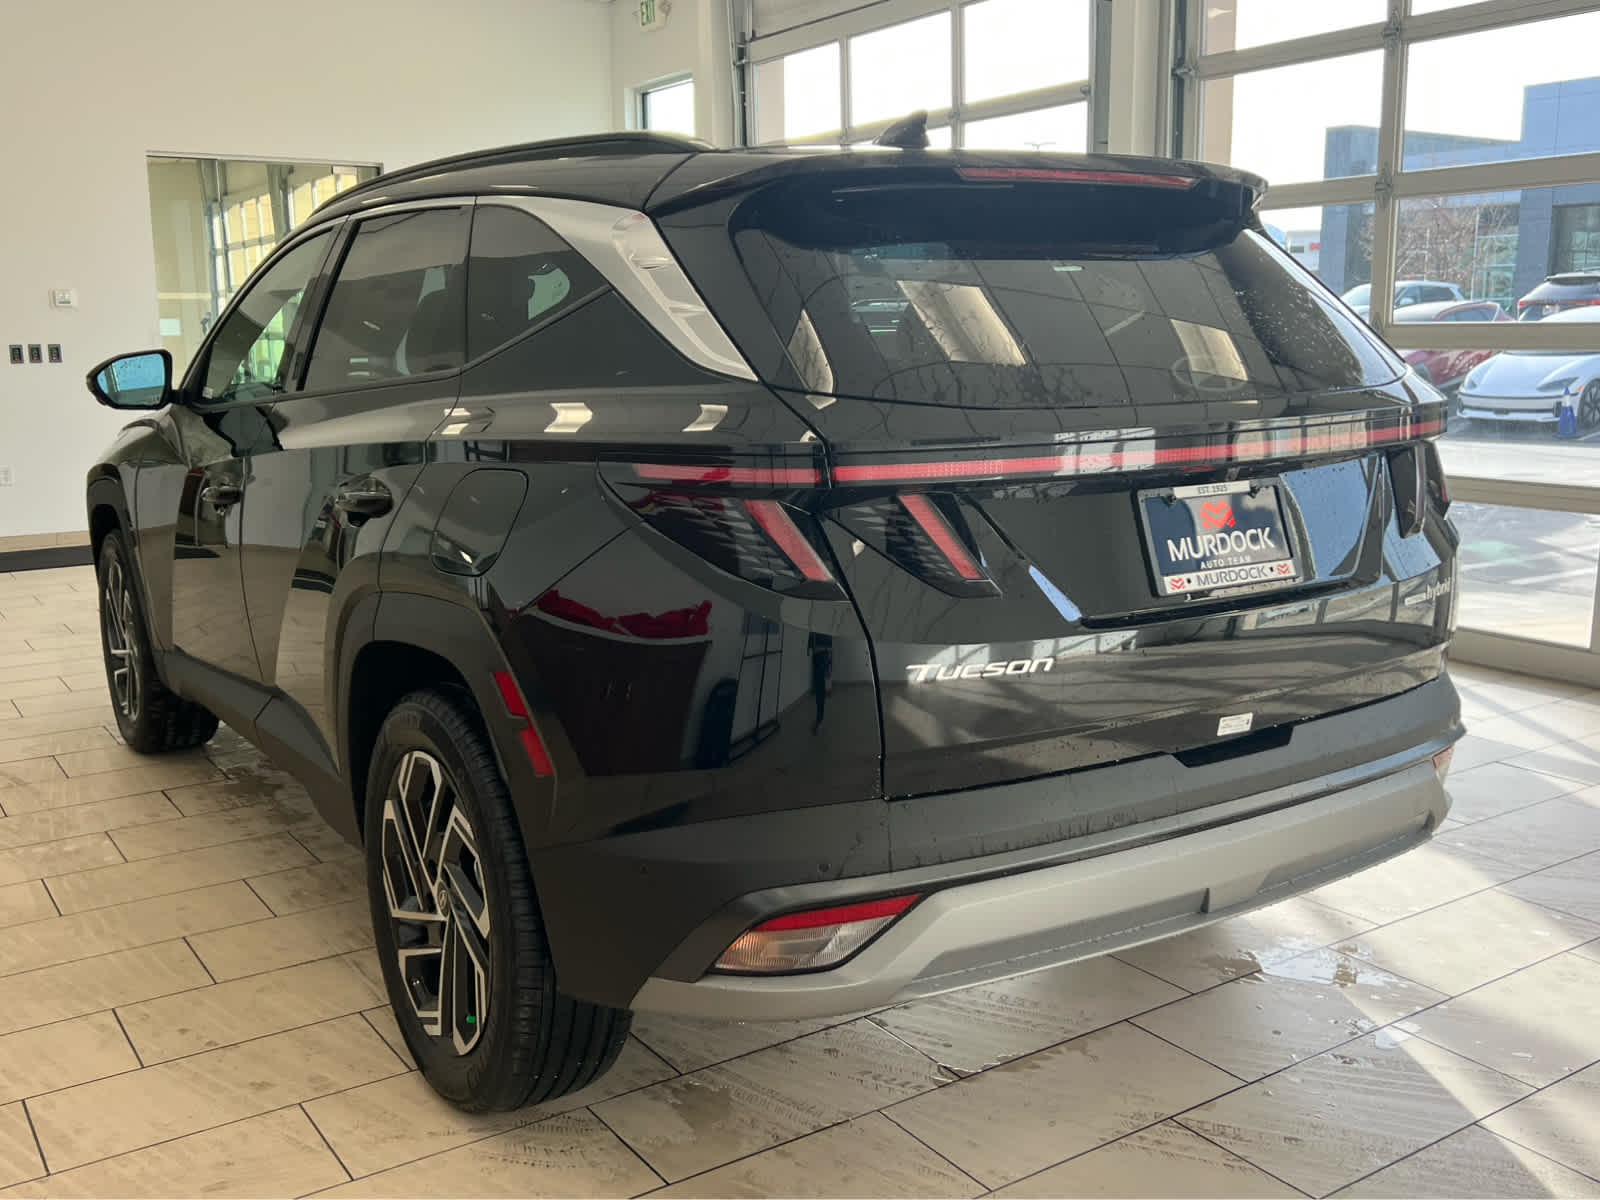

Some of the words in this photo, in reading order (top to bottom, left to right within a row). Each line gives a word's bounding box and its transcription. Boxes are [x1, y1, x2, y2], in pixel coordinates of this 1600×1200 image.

[640, 0, 656, 26] EXIT
[1167, 527, 1275, 562] MURDOCK
[1200, 559, 1225, 569] AUTO
[1227, 555, 1251, 565] TEAM
[1196, 566, 1268, 586] MURDOCK
